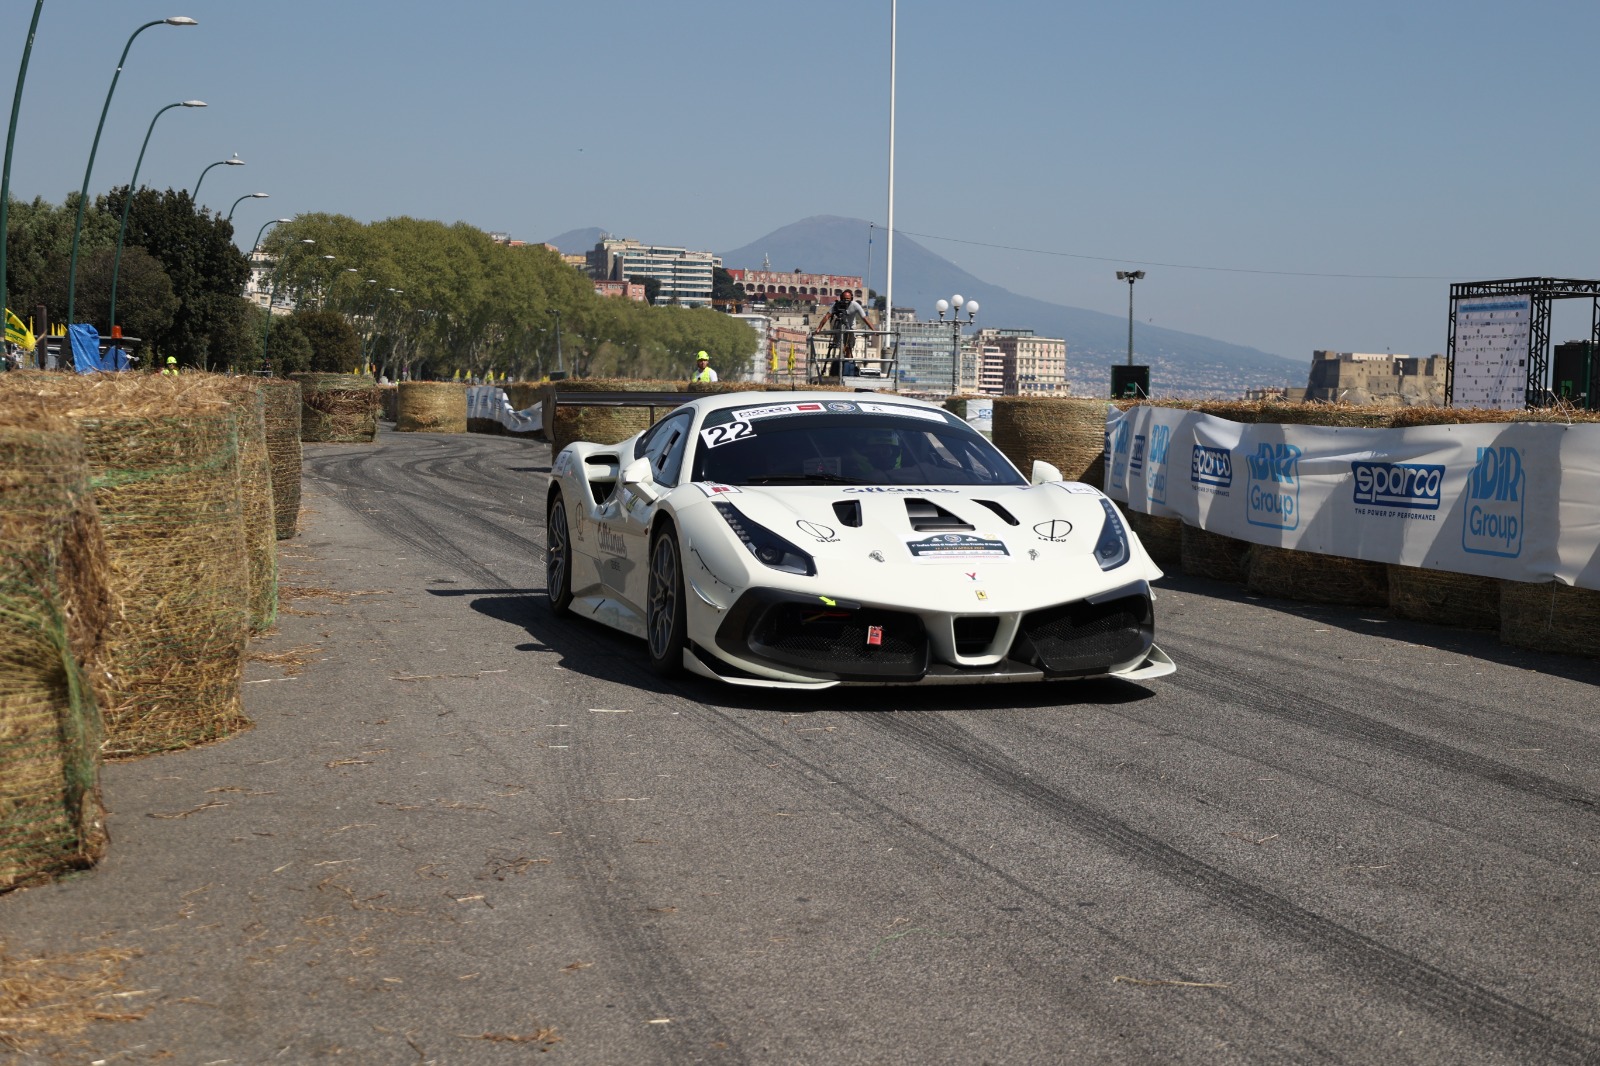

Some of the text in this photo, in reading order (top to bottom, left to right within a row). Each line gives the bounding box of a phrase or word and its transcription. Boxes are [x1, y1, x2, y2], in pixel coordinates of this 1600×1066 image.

[707, 421, 751, 446] 22
[1192, 448, 1231, 481] sparco
[1356, 466, 1441, 503] sparco
[1250, 484, 1294, 522] Group
[1354, 507, 1436, 521] THE POWER OF PERFORMANCE
[1469, 505, 1518, 548] Group
